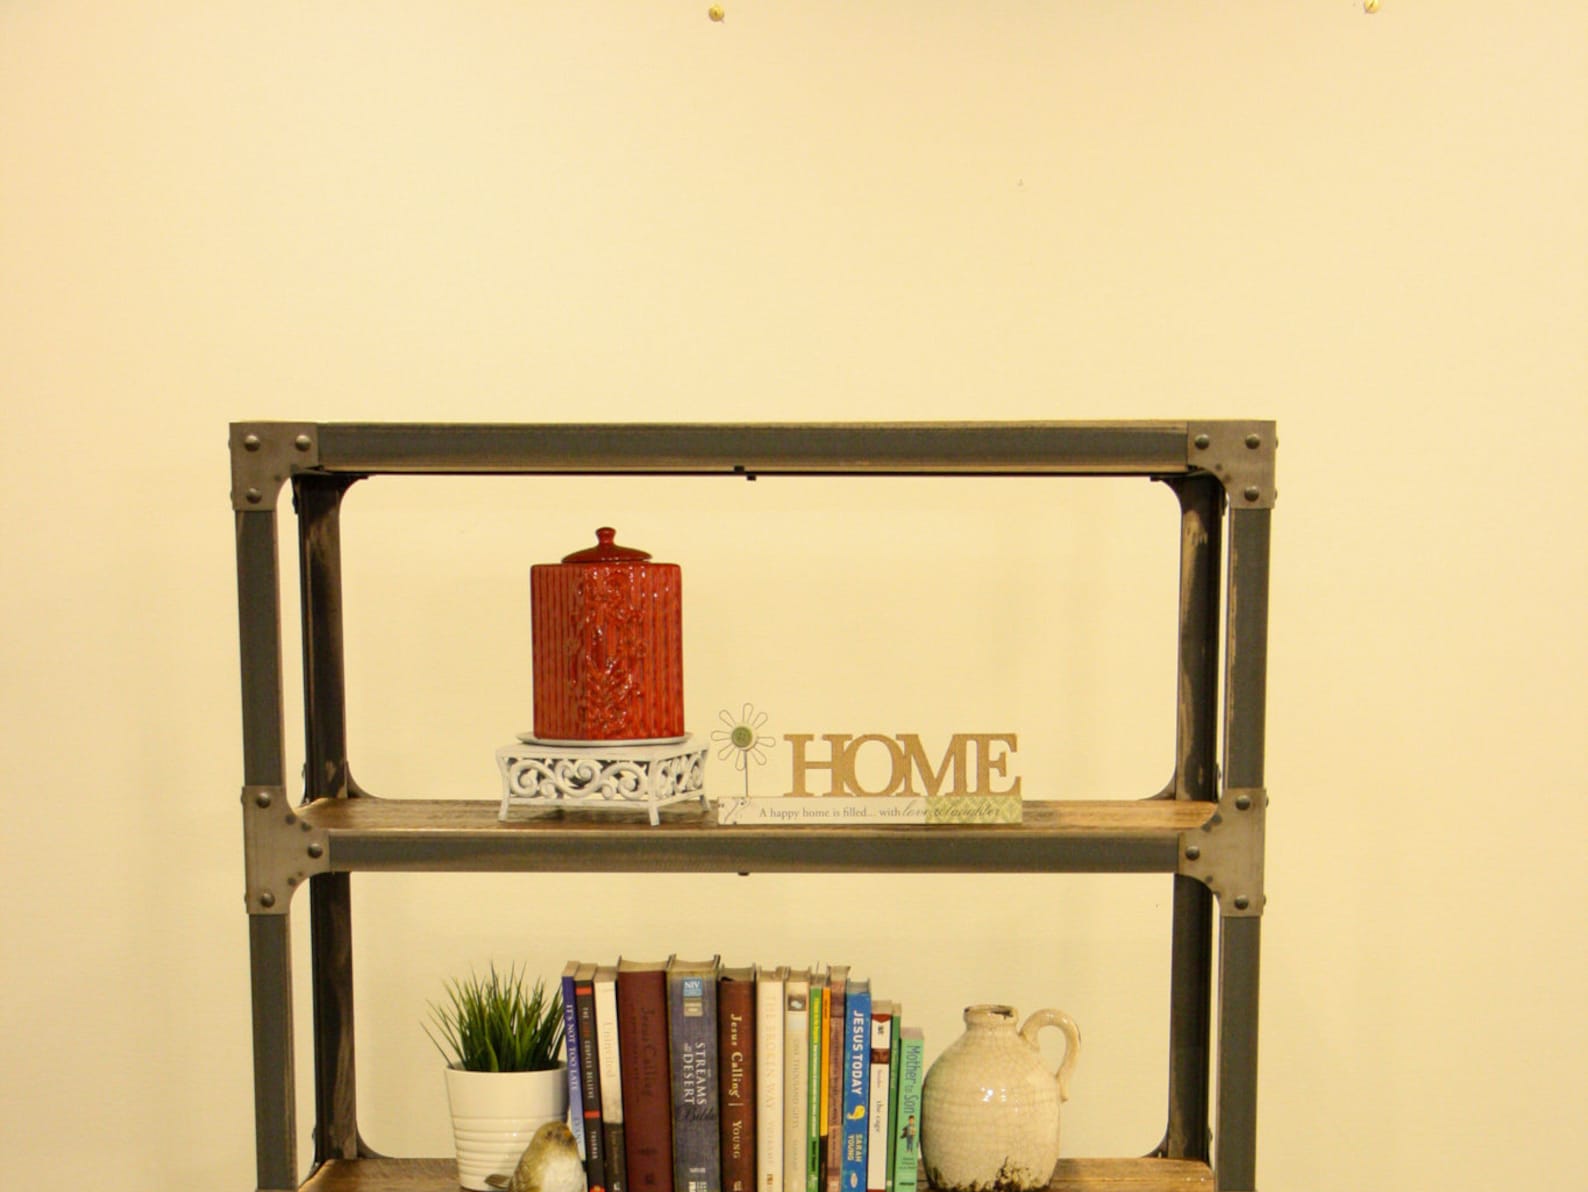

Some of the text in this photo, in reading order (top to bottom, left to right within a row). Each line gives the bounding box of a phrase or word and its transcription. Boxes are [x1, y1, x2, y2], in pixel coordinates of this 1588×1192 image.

[783, 733, 1022, 797] HOME
[759, 807, 767, 817] A
[770, 807, 800, 820] happy
[802, 807, 830, 817] home
[832, 807, 841, 817] is
[879, 806, 900, 817] with
[566, 1005, 578, 1090] IT'S NOT TOO LATE
[584, 1040, 592, 1069] COUPLES
[728, 1013, 744, 1099] Jesus Calling
[851, 1010, 864, 1095] JESUS TODAY
[905, 1045, 920, 1084] Mother
[586, 1071, 594, 1099] BELIEVE
[683, 1053, 696, 1105] DESERT
[695, 1042, 707, 1105] STREAMS
[904, 1094, 919, 1114] Son
[732, 1120, 742, 1159] YOUNG
[847, 1135, 855, 1161] YOUNG
